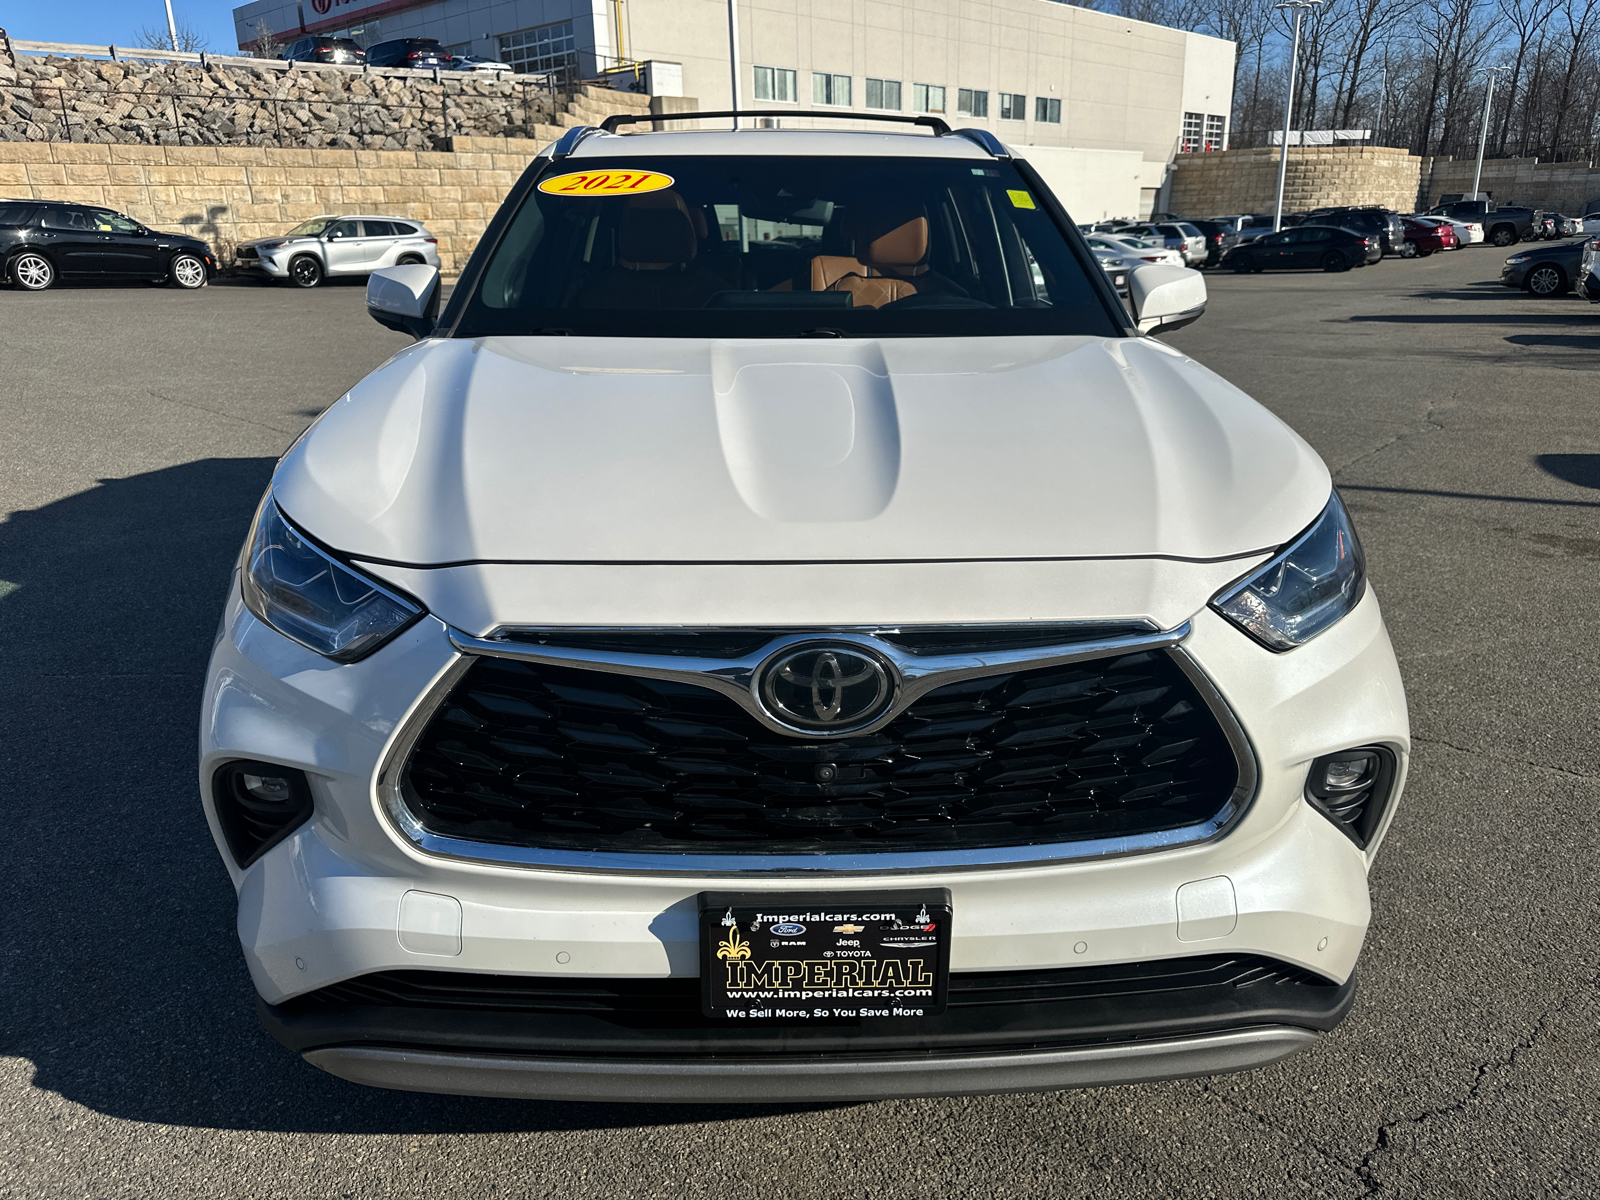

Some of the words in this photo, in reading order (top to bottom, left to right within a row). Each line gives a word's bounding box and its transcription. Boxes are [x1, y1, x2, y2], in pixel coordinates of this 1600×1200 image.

[558, 174, 652, 191] 2021
[756, 911, 896, 924] Imperialcars.com
[836, 938, 860, 947] Jeep
[726, 959, 933, 989] IMPERIAL
[726, 988, 932, 1000] www.imperialcars.com
[726, 1009, 746, 1018] We
[749, 1008, 772, 1018] Sell
[776, 1009, 810, 1019] More,
[813, 1008, 830, 1017] So
[832, 1008, 856, 1017] You
[859, 1008, 890, 1017] Save
[892, 1007, 924, 1017] More
